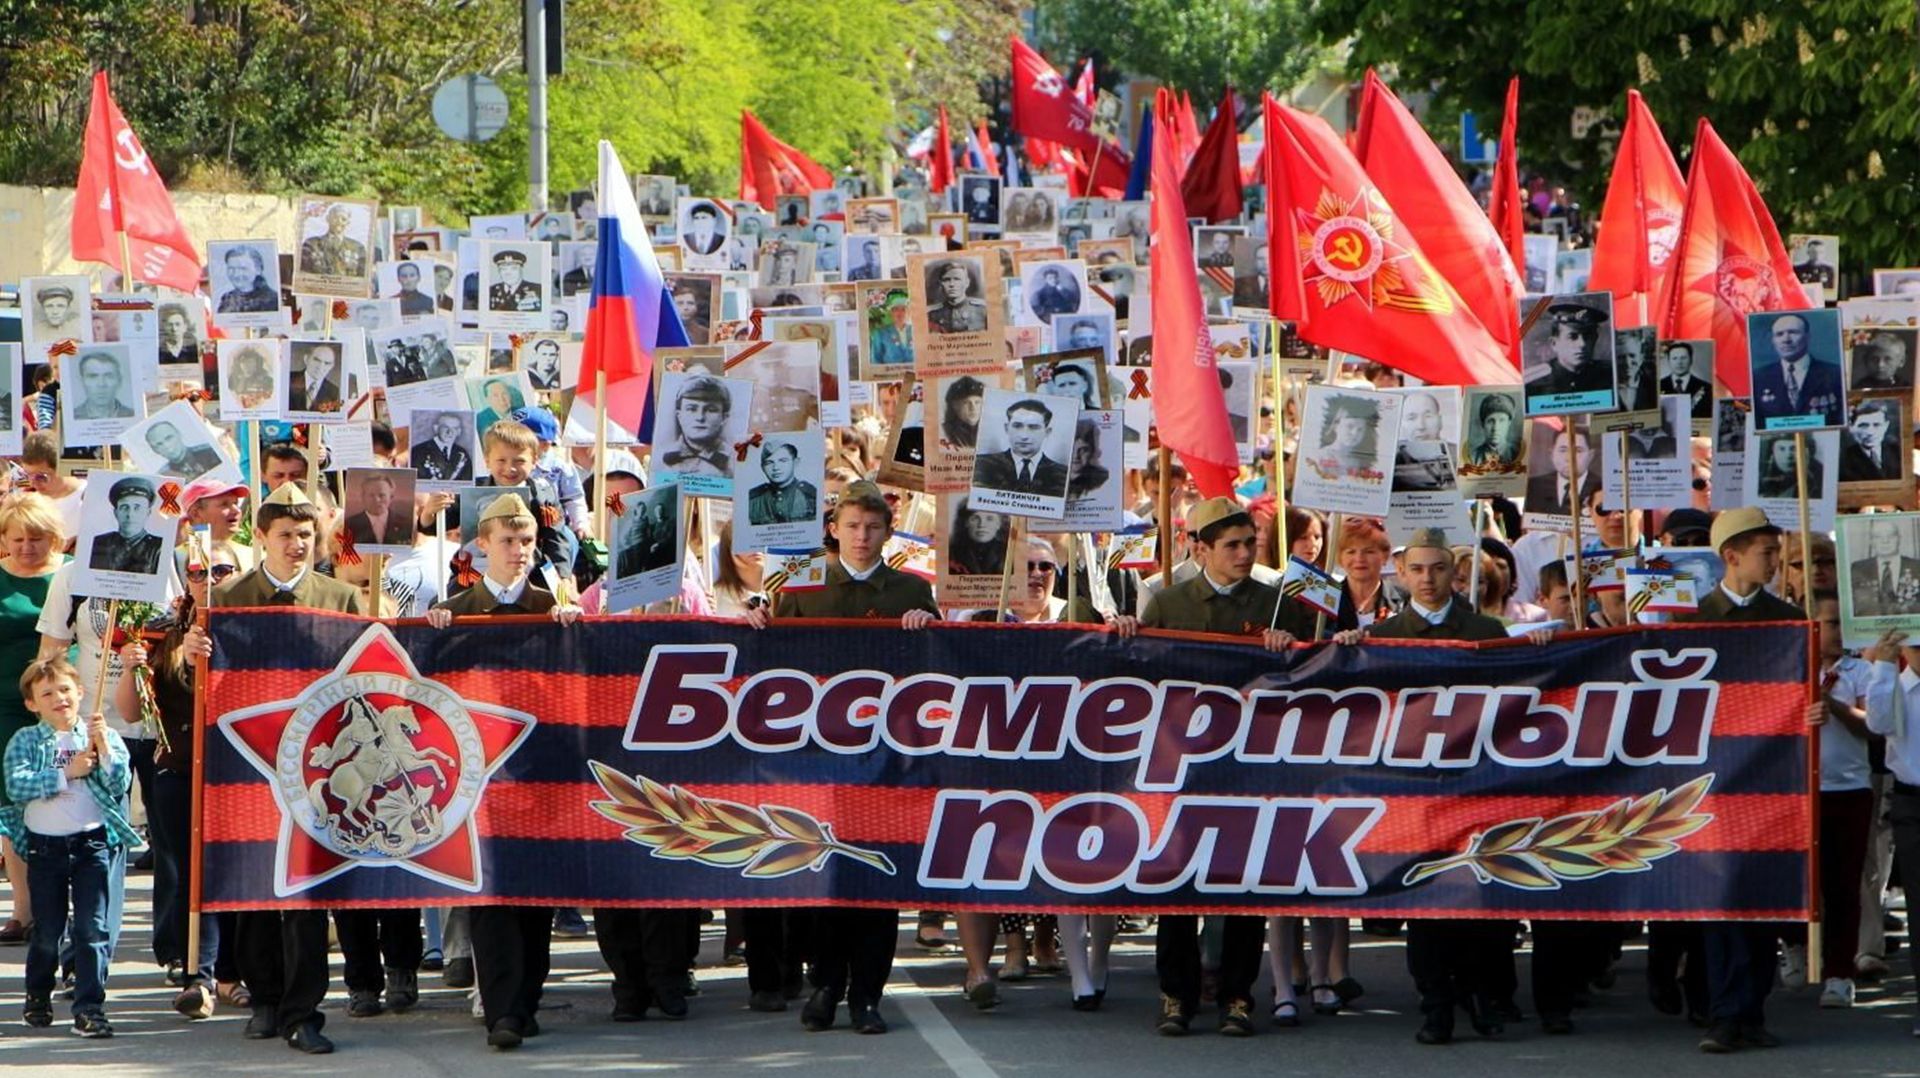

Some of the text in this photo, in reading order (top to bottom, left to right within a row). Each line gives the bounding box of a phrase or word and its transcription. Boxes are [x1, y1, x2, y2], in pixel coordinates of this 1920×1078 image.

[283, 675, 481, 800] БЕССМЕРТНЫЙ ПОЛК РОССИИ
[622, 644, 1719, 792] Бессмертный
